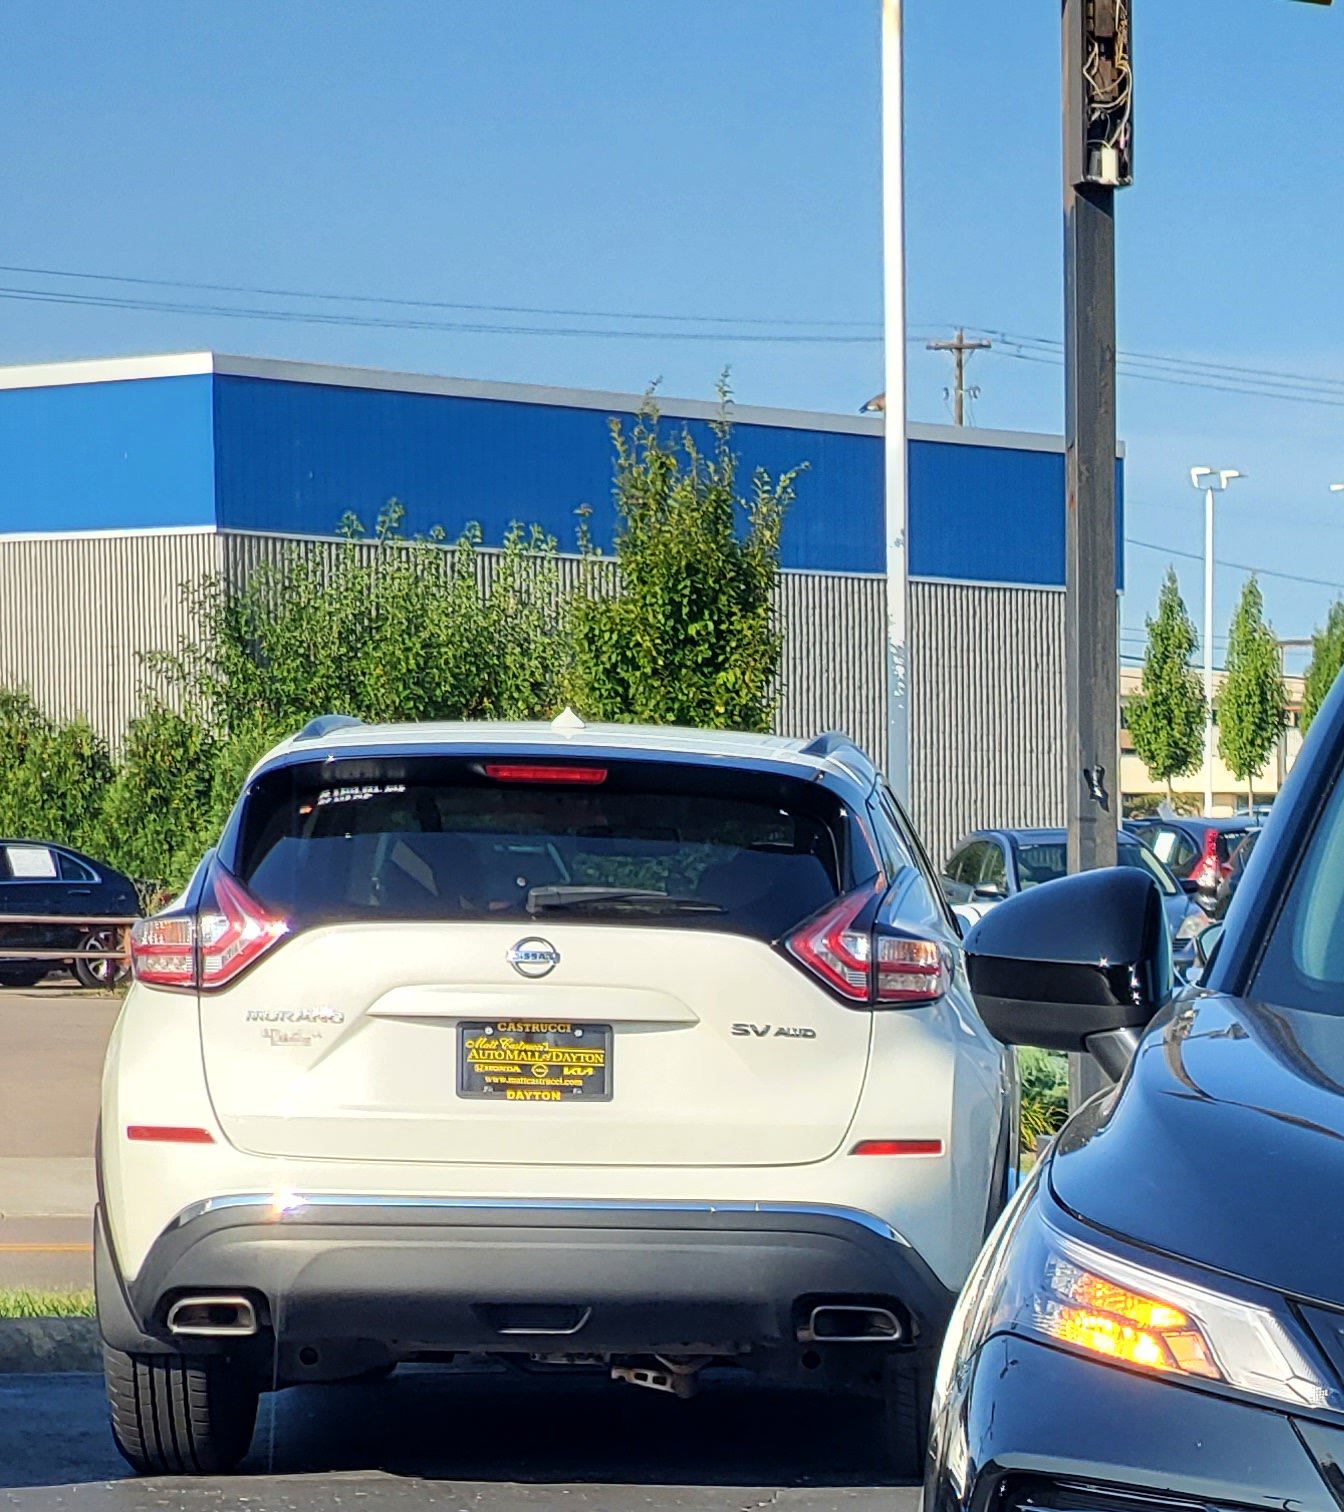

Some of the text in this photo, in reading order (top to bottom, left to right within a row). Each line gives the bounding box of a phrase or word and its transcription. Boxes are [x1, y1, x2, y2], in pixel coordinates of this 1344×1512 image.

[497, 1022, 572, 1033] CASTRUCCI
[731, 1023, 817, 1039] SV AWD
[553, 1051, 605, 1063] DAYTON
[506, 1089, 561, 1100] DAYTON
